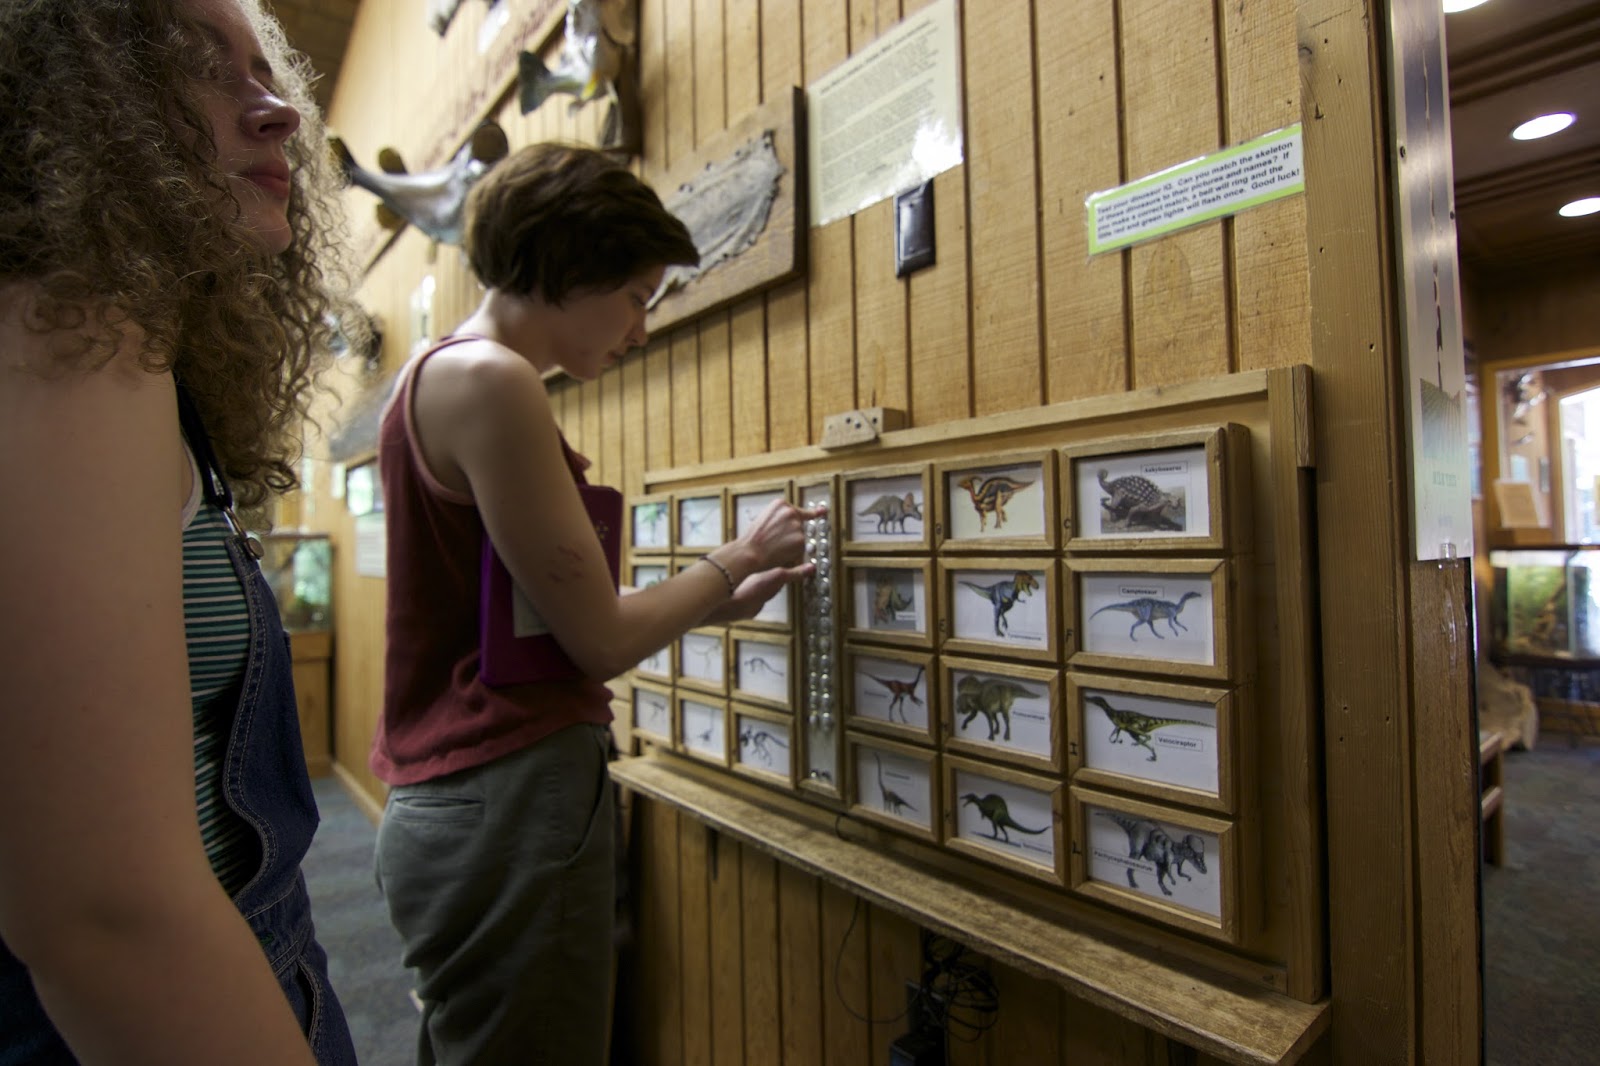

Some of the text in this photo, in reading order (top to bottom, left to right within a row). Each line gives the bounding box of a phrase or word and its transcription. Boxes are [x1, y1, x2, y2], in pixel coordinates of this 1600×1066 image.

[1130, 188, 1162, 203] dinosaur
[1178, 176, 1193, 186] Can
[1194, 170, 1210, 181] you
[1212, 160, 1237, 174] match
[1240, 156, 1253, 164] the
[1255, 141, 1293, 159] skeleton
[1172, 187, 1189, 197] their
[1191, 176, 1223, 192] pictures
[1226, 168, 1242, 179] and
[1244, 156, 1278, 173] names?
[1282, 152, 1290, 160] If
[1126, 221, 1140, 230] and
[1141, 215, 1162, 227] green
[1163, 207, 1184, 218] lights
[1186, 200, 1200, 210] will
[1202, 194, 1222, 206] flash
[1224, 188, 1247, 200] once.
[1251, 177, 1276, 190] Good
[1278, 168, 1300, 182] luck!
[1138, 205, 1164, 218] correct
[1199, 187, 1214, 197] bell
[1215, 181, 1230, 192] will
[1232, 176, 1248, 187] ring
[1250, 170, 1267, 180] and
[1269, 164, 1283, 174] the
[1064, 518, 1070, 530] C
[1065, 628, 1072, 643] F
[1158, 736, 1196, 748] Velociraptor
[1072, 840, 1082, 856] L
